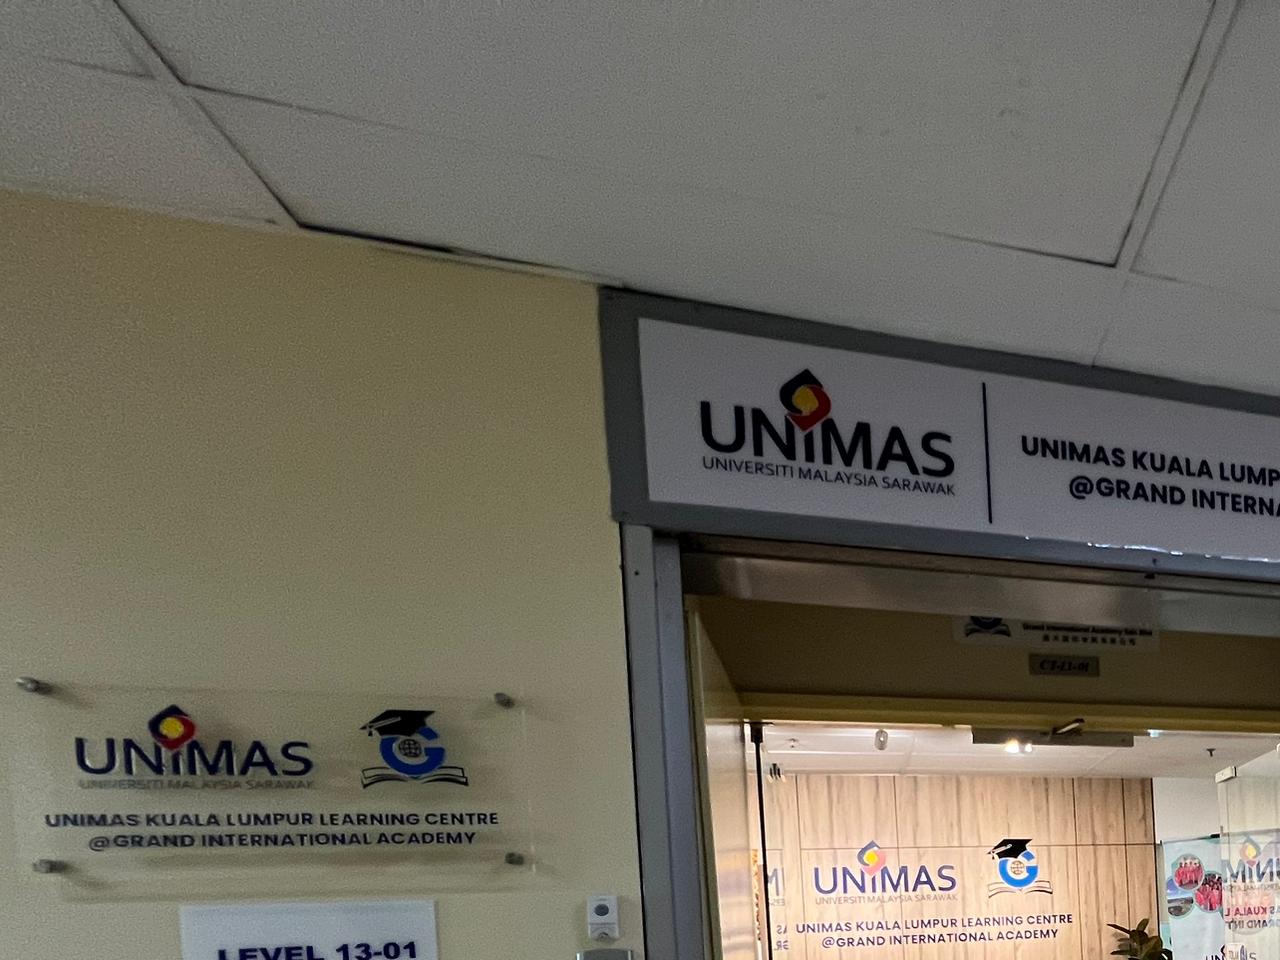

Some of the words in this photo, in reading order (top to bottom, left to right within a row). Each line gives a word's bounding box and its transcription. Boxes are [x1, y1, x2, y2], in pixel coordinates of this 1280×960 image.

[700, 400, 955, 478] UNIMAS
[1021, 435, 1126, 468] UNIMAS
[1132, 450, 1214, 480] KUALA
[702, 456, 794, 479] UNIVERSITI
[798, 466, 878, 489] MALAYSIA
[882, 476, 956, 496] SARAWAK
[1068, 475, 1187, 506] @GRAND
[75, 737, 313, 777] UNIMAS
[79, 779, 164, 790] UNIVERSITI
[168, 779, 243, 790] MALAYSIA
[246, 779, 315, 790] SARAWAK
[45, 814, 140, 827] UNIMAS
[146, 814, 220, 826] KUALA
[227, 813, 313, 826] LUMPUR
[320, 813, 419, 826] LEARNING
[425, 812, 498, 825] CENTRE
[89, 834, 195, 851] @GRAND
[202, 832, 371, 847] INTERNATIONAL
[377, 832, 476, 845] ACADEMY
[814, 865, 957, 895] UNIMAS
[815, 896, 866, 905] UNIVERSITI
[867, 894, 912, 904] MALAYSIA
[914, 893, 958, 903] SARAWAK
[796, 920, 852, 934] UNIMAS
[856, 918, 902, 932] KUALA
[905, 917, 958, 930] LUMPUR
[962, 915, 1023, 928] LEARNING
[1027, 913, 1073, 925] CENTRE
[821, 935, 885, 949] @GRAND
[889, 931, 993, 946] INTERNATIONAL
[996, 928, 1059, 941] ACADEMY
